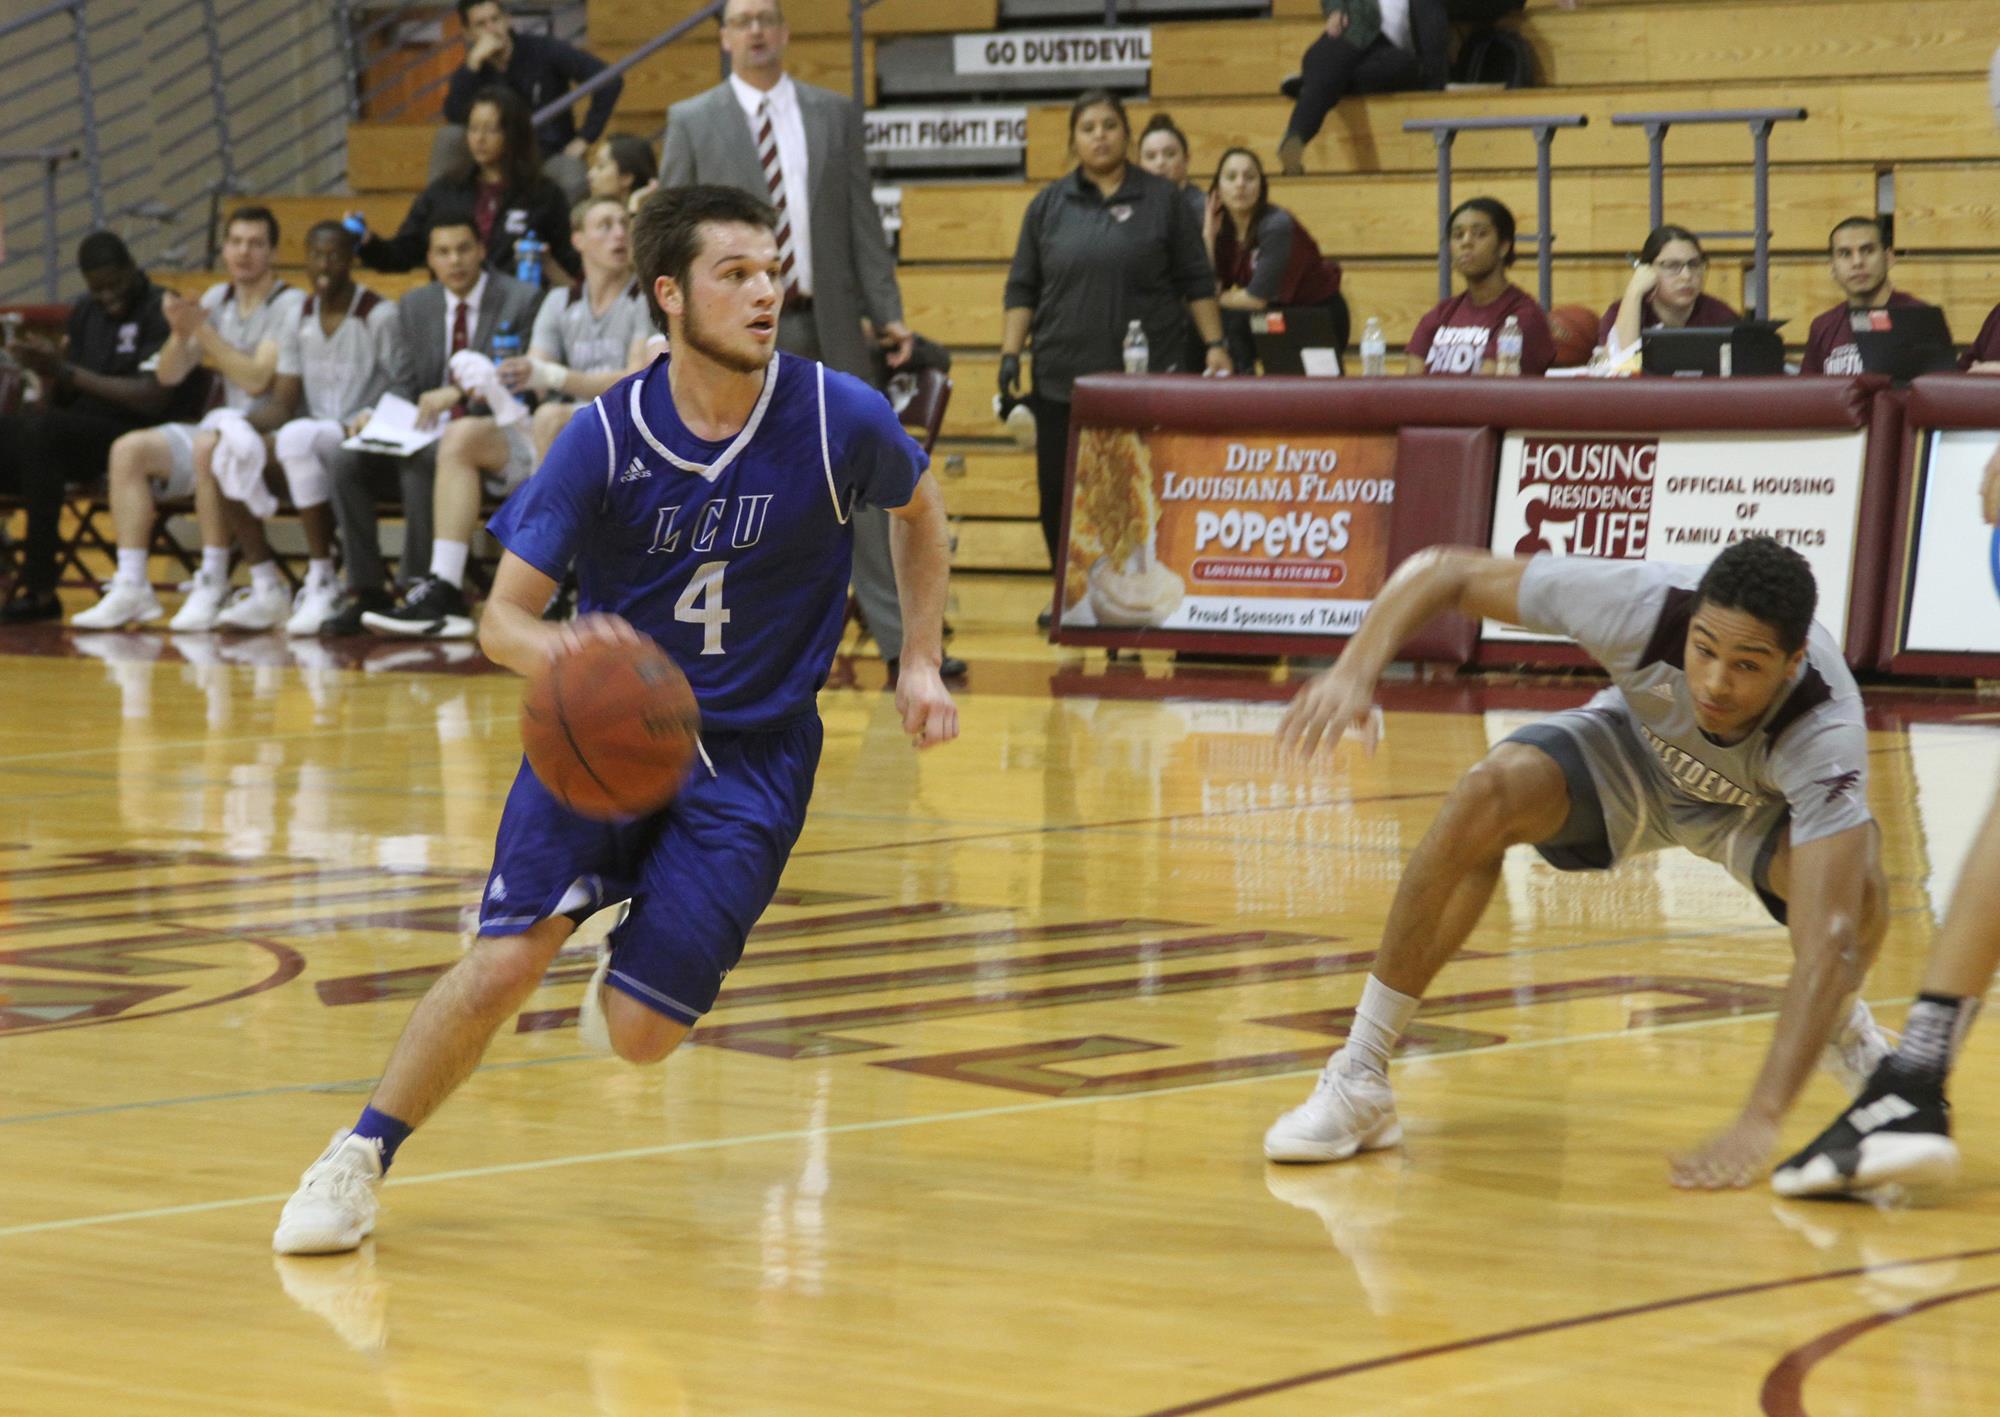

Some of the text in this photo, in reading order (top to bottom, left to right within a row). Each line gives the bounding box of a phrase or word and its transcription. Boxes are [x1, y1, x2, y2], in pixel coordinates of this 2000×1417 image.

[985, 41, 1016, 64] GO
[919, 121, 987, 143] FIGHT!
[1225, 443, 1338, 473] DIP INTO
[1520, 444, 1658, 481] HOUSING
[1162, 472, 1396, 504] LOUISIANA FLAVOR
[1550, 484, 1652, 511] RESIDENCE
[1667, 477, 1836, 495] OFFICIAL HOUSING
[1736, 503, 1760, 519] OF
[647, 494, 773, 554] LCU
[1573, 511, 1650, 558] LIFE
[1665, 527, 1721, 545] TAMIU
[1203, 563, 1332, 580] LOUISIANA KITCHEN
[674, 561, 730, 655] 4
[1188, 605, 1230, 623] Proud
[1233, 606, 1295, 629] Sponsors
[1300, 609, 1315, 625] of
